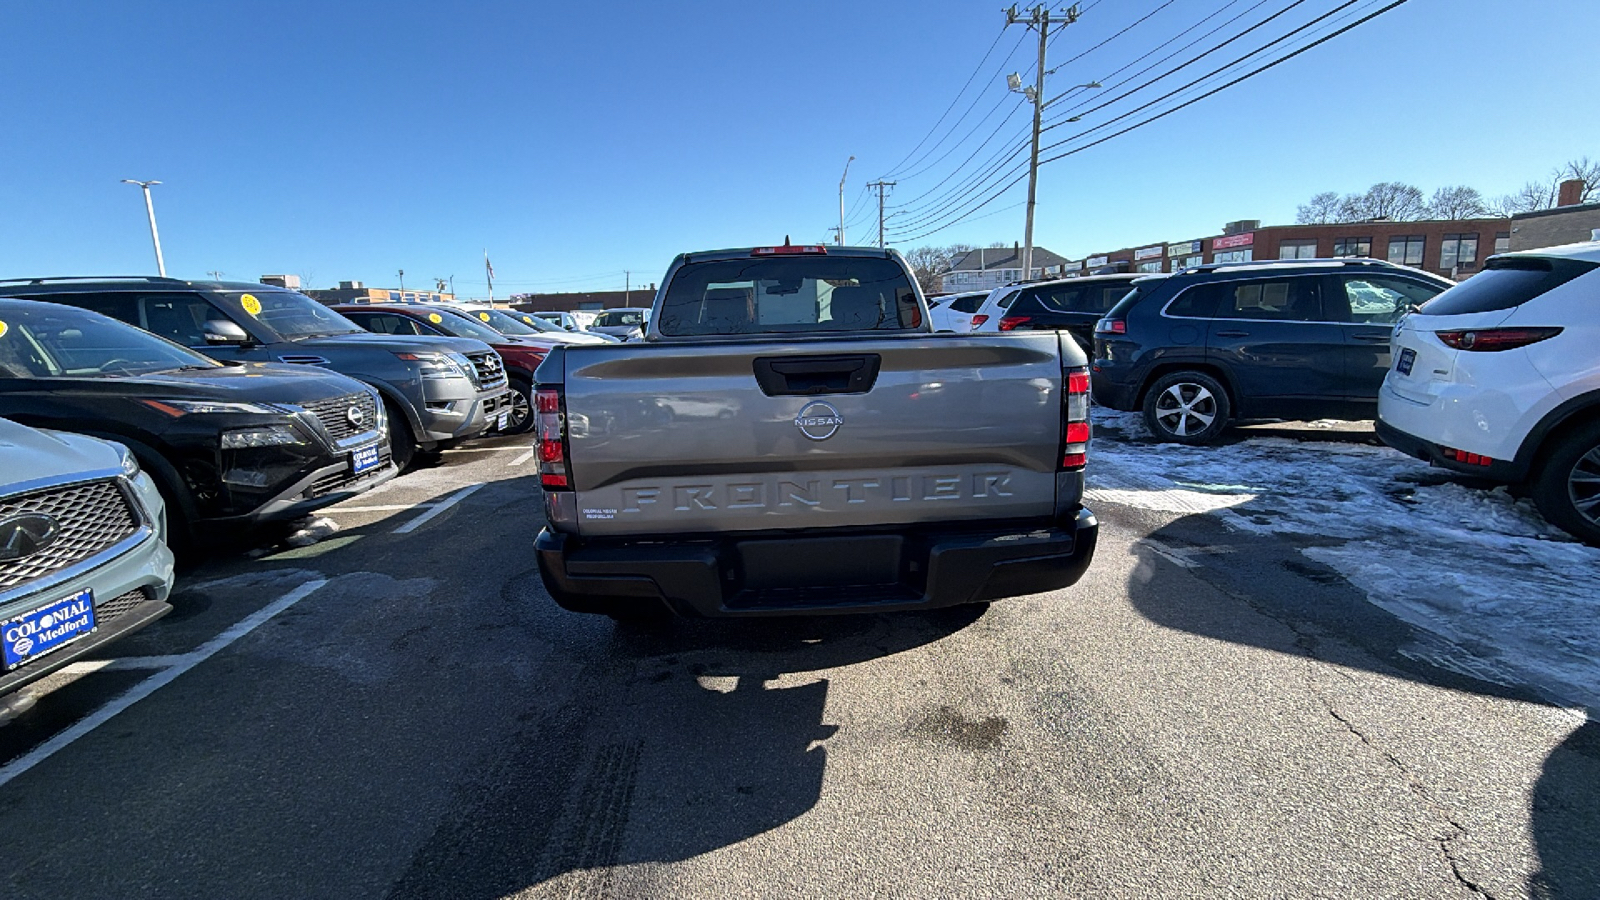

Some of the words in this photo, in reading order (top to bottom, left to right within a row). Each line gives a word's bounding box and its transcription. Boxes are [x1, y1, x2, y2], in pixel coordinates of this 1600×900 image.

[794, 417, 843, 426] NISSAN
[621, 471, 1013, 513] FRONTIER
[6, 600, 89, 642] COLONIAL
[38, 614, 88, 643] Medford
